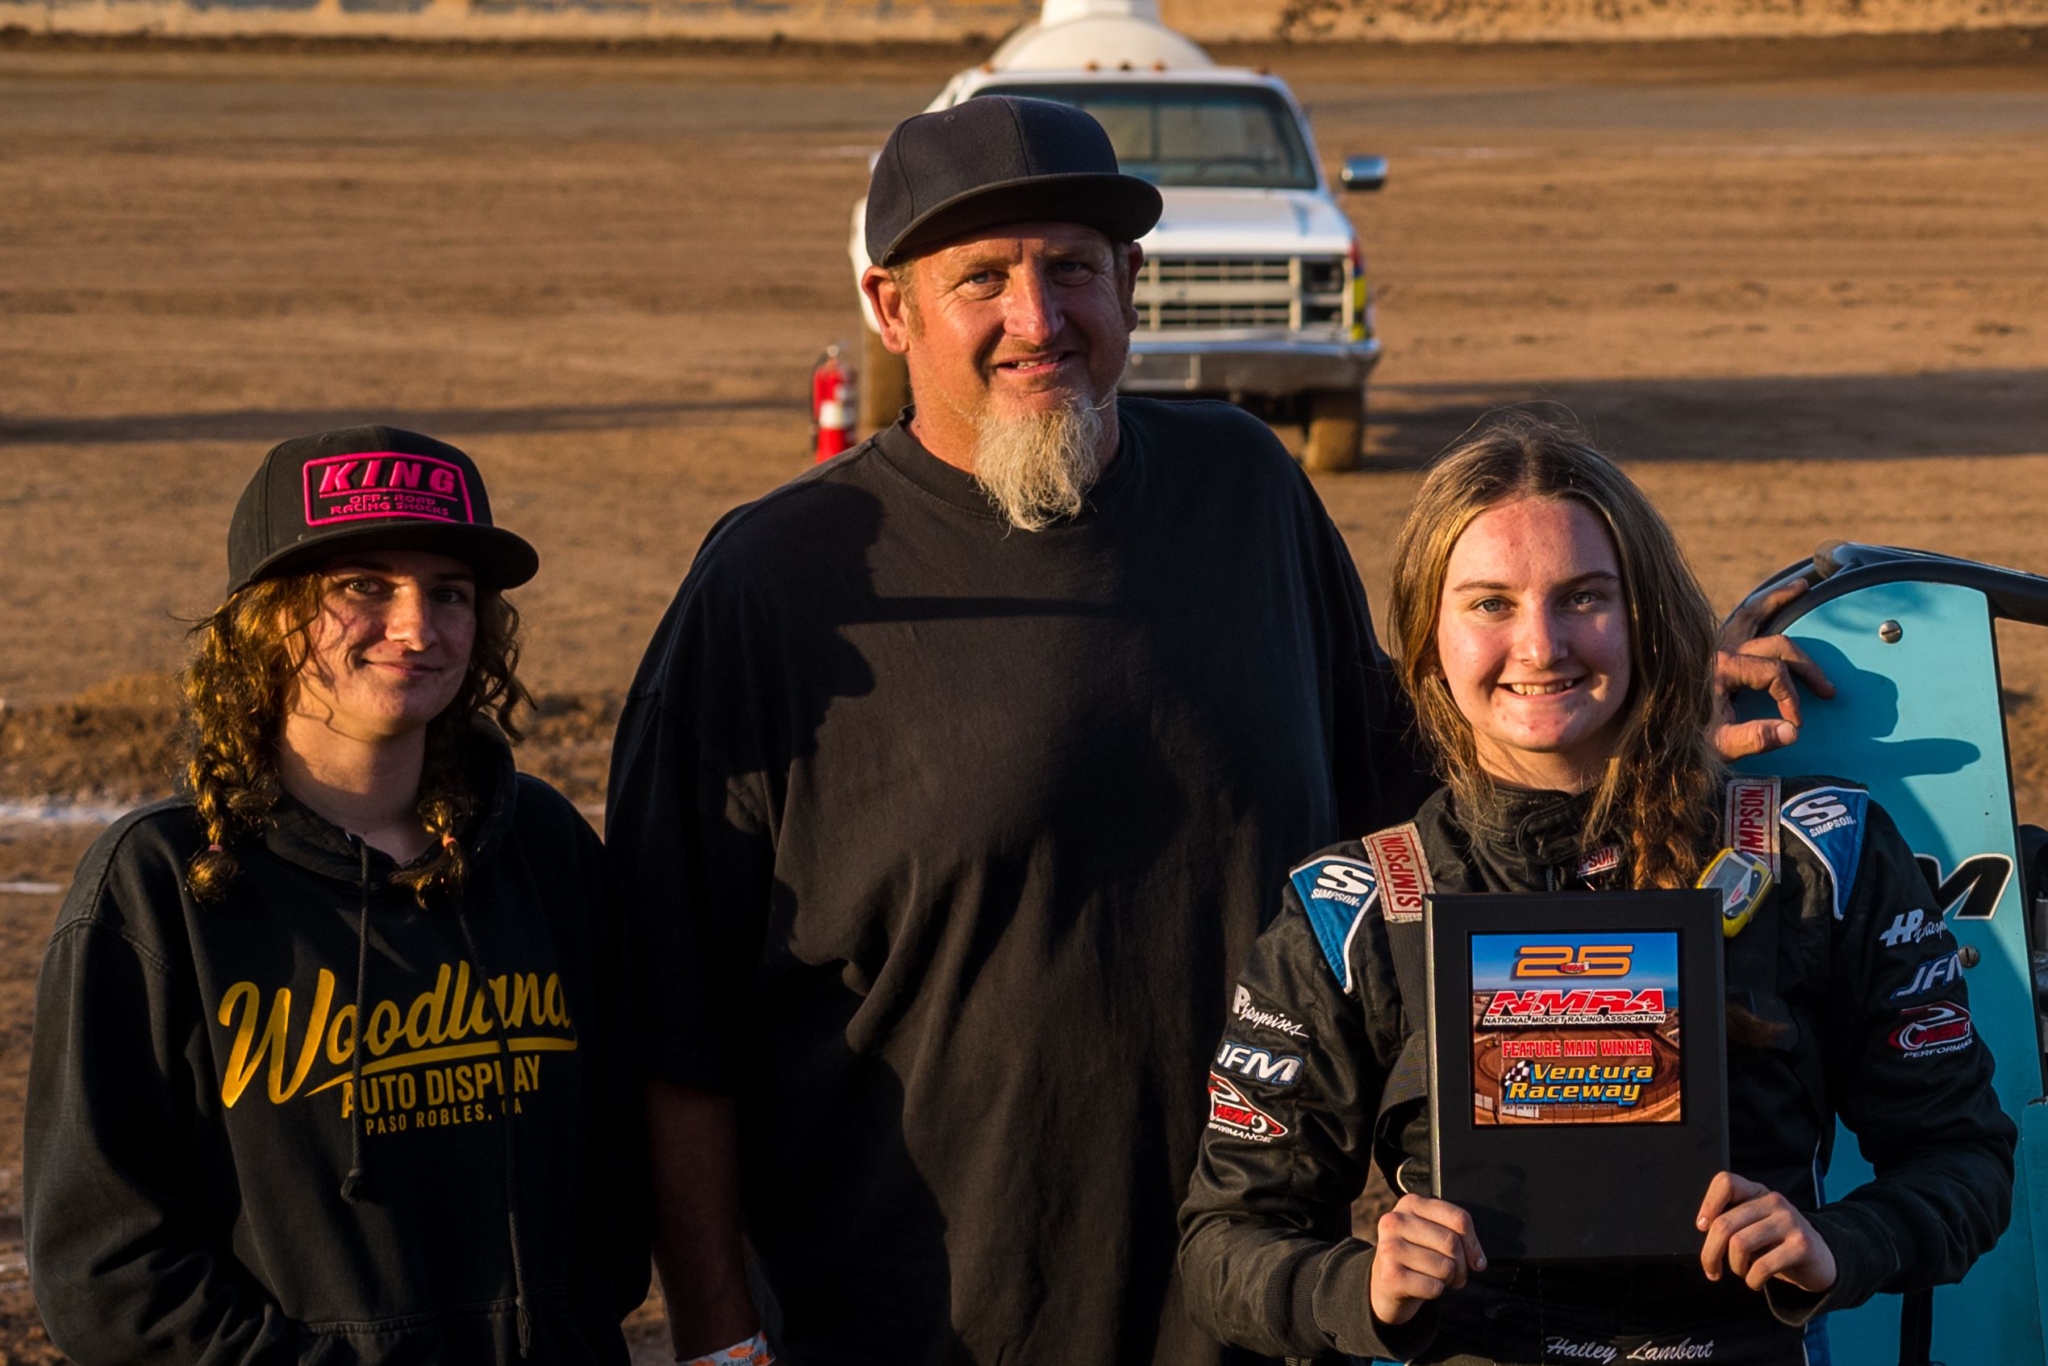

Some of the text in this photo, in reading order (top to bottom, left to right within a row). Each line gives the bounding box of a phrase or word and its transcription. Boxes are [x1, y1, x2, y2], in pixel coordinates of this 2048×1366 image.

[319, 459, 456, 493] KING
[330, 502, 449, 516] RACING SHOCKS
[1739, 789, 1765, 856] IMPSON
[1379, 835, 1422, 908] SIMPSON
[1515, 945, 1634, 978] 25
[1486, 988, 1666, 1015] NMRA
[1484, 1014, 1665, 1025] NATIONAL MIDGET RACING ASSOCIATION
[1502, 1039, 1653, 1058] FEATURE MAIN WINNER
[1531, 1063, 1654, 1082] Ventura
[340, 1072, 417, 1119] AUTO
[1507, 1082, 1642, 1102] Raceway
[365, 1112, 408, 1137] PASO
[416, 1103, 494, 1130] ROBLES,
[1545, 1336, 1715, 1365] Hailey Lambert
